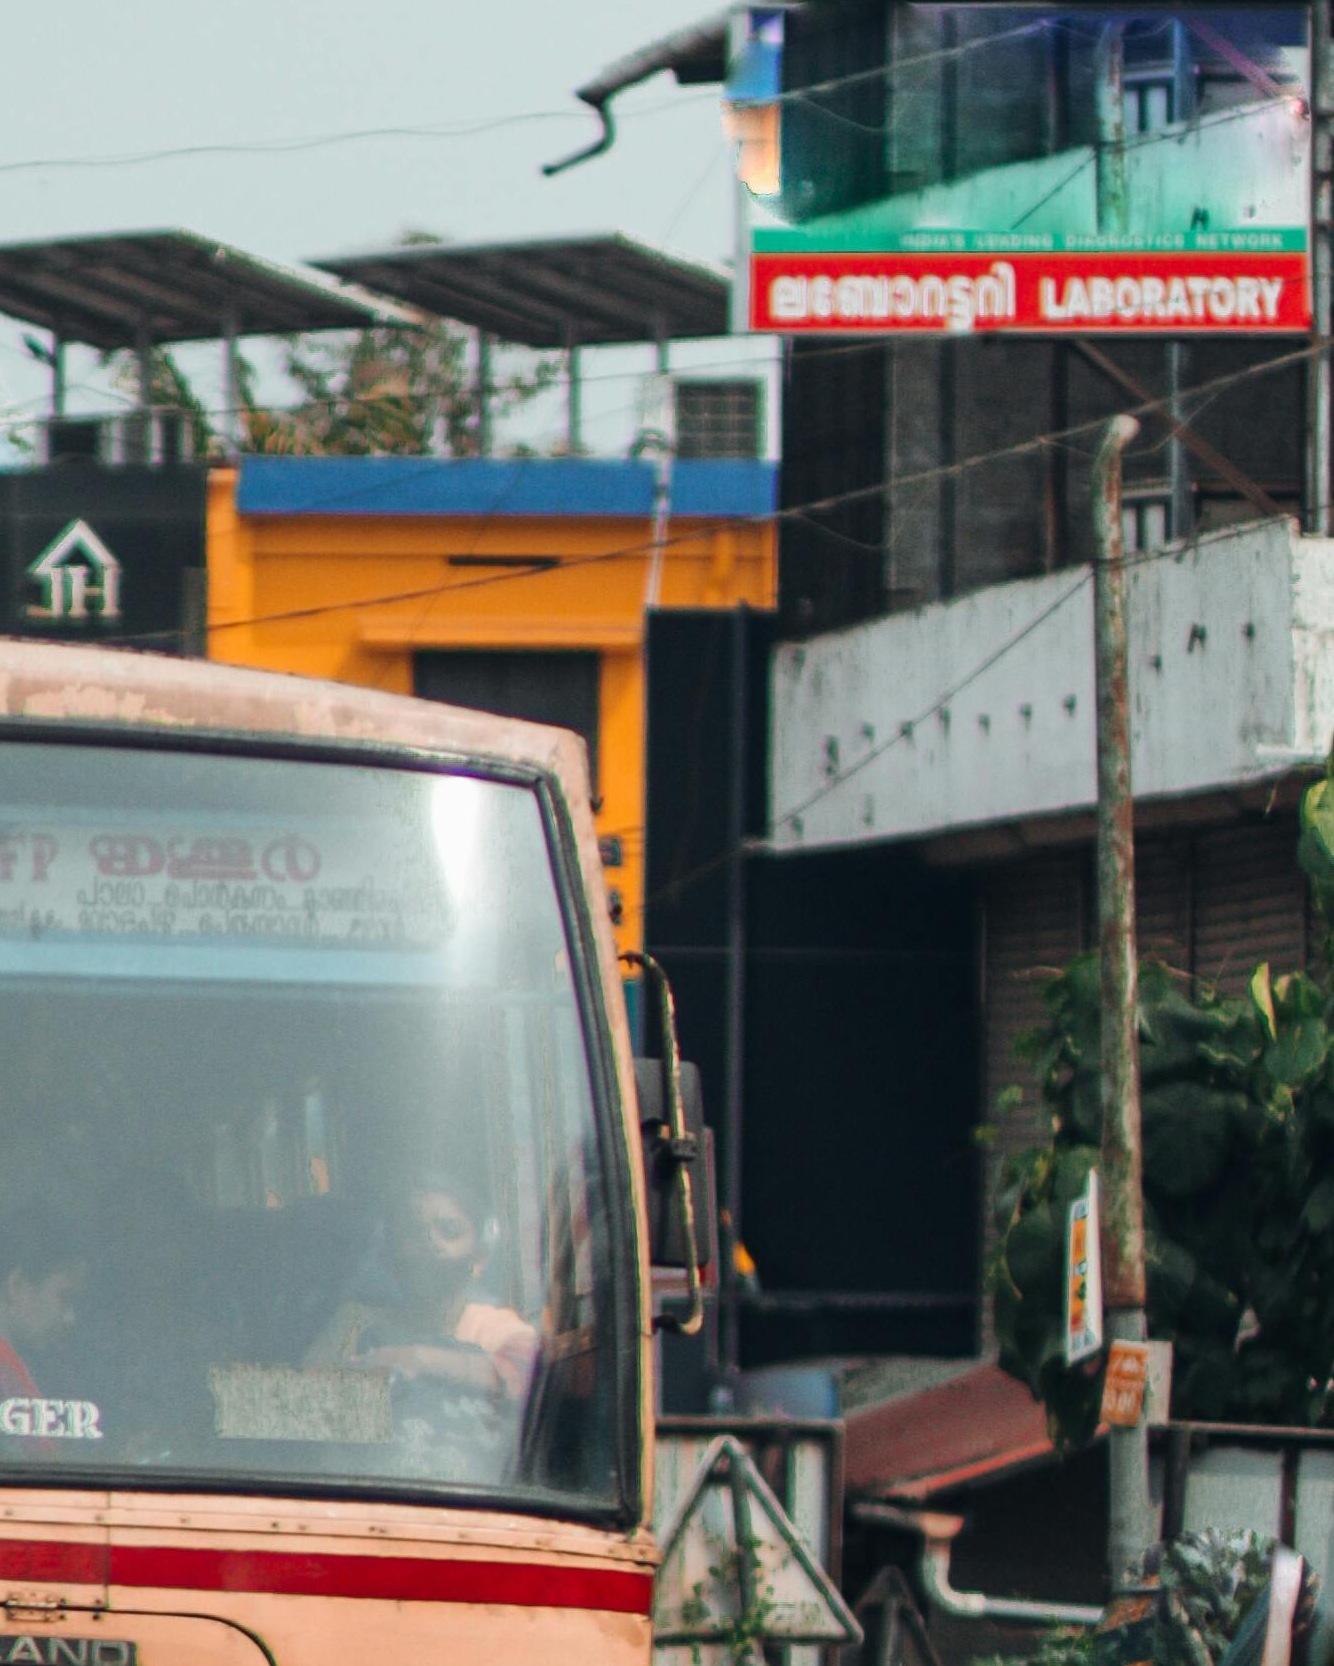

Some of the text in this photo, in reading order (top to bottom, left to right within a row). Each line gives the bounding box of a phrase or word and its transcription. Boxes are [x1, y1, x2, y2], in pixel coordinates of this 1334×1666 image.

[976, 233, 1053, 248] LEADING
[1195, 233, 1284, 248] NETWORK
[1038, 275, 1285, 321] LABORATORY
